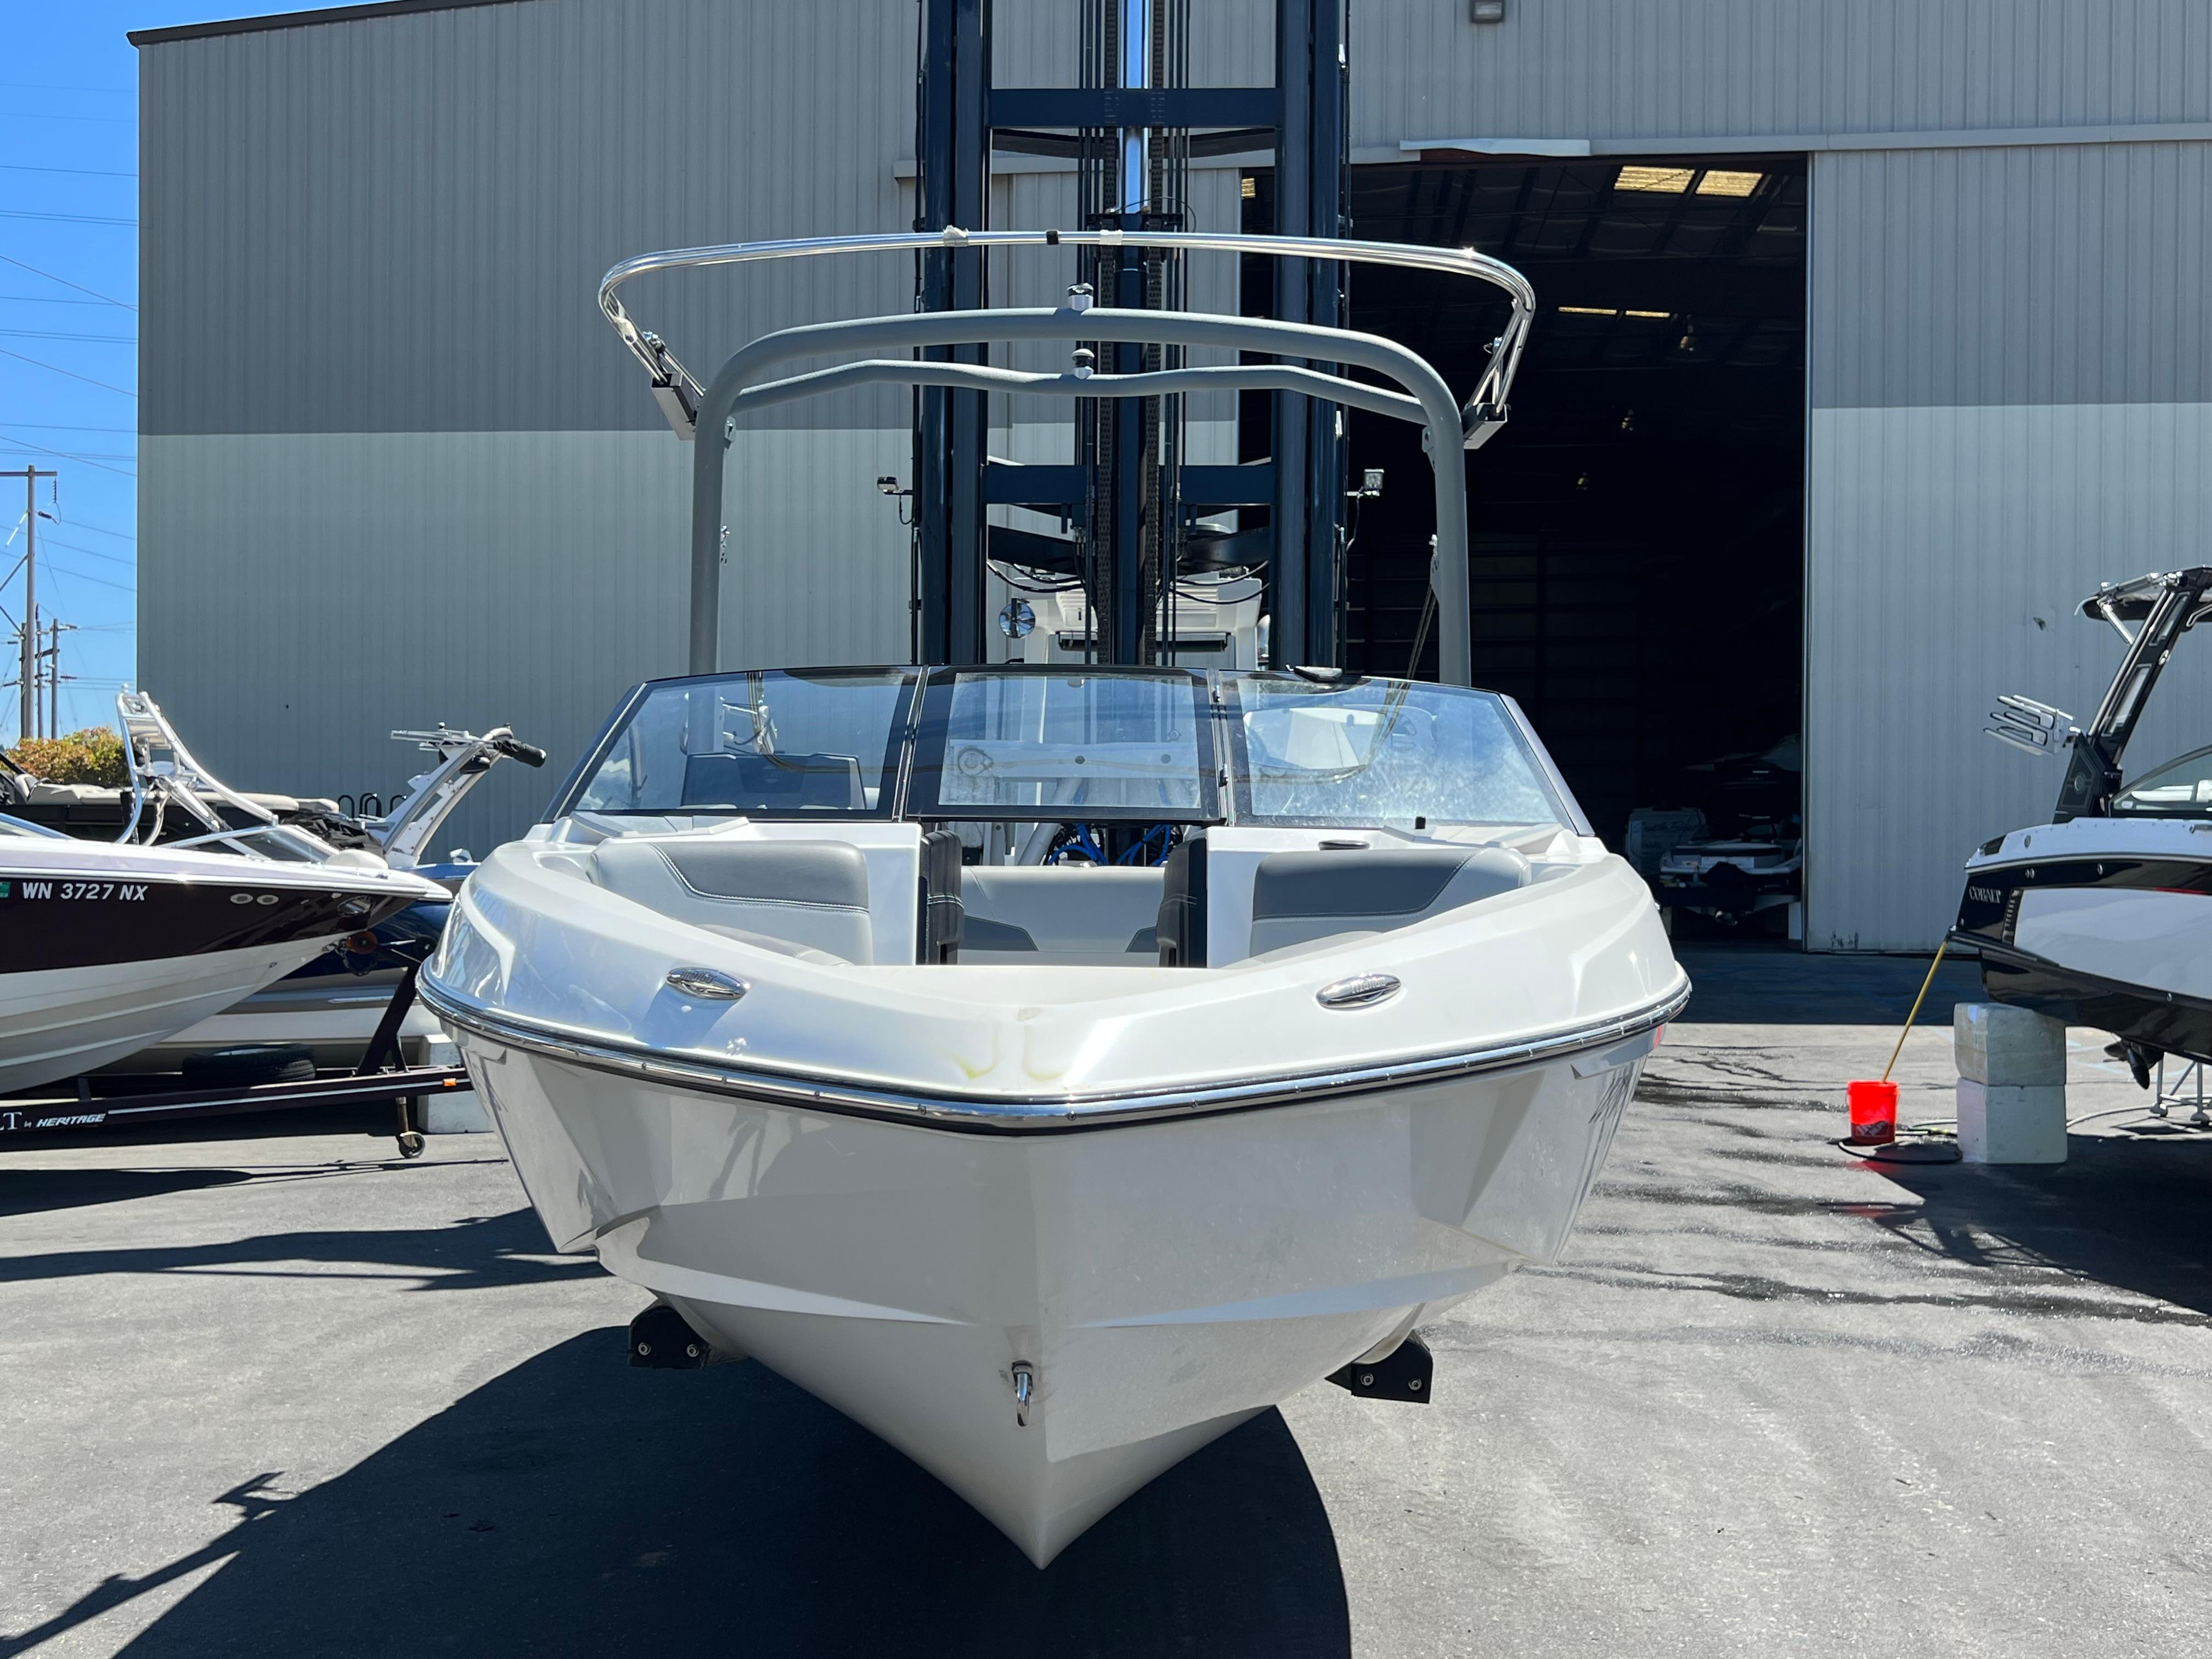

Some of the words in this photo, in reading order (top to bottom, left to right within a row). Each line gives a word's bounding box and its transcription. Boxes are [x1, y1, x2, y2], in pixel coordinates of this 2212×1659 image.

[23, 882, 53, 899] WN
[60, 883, 114, 900] 3727
[119, 884, 148, 901] NX
[1969, 886, 2001, 904] COBALT
[36, 1113, 106, 1127] HERITAGE
